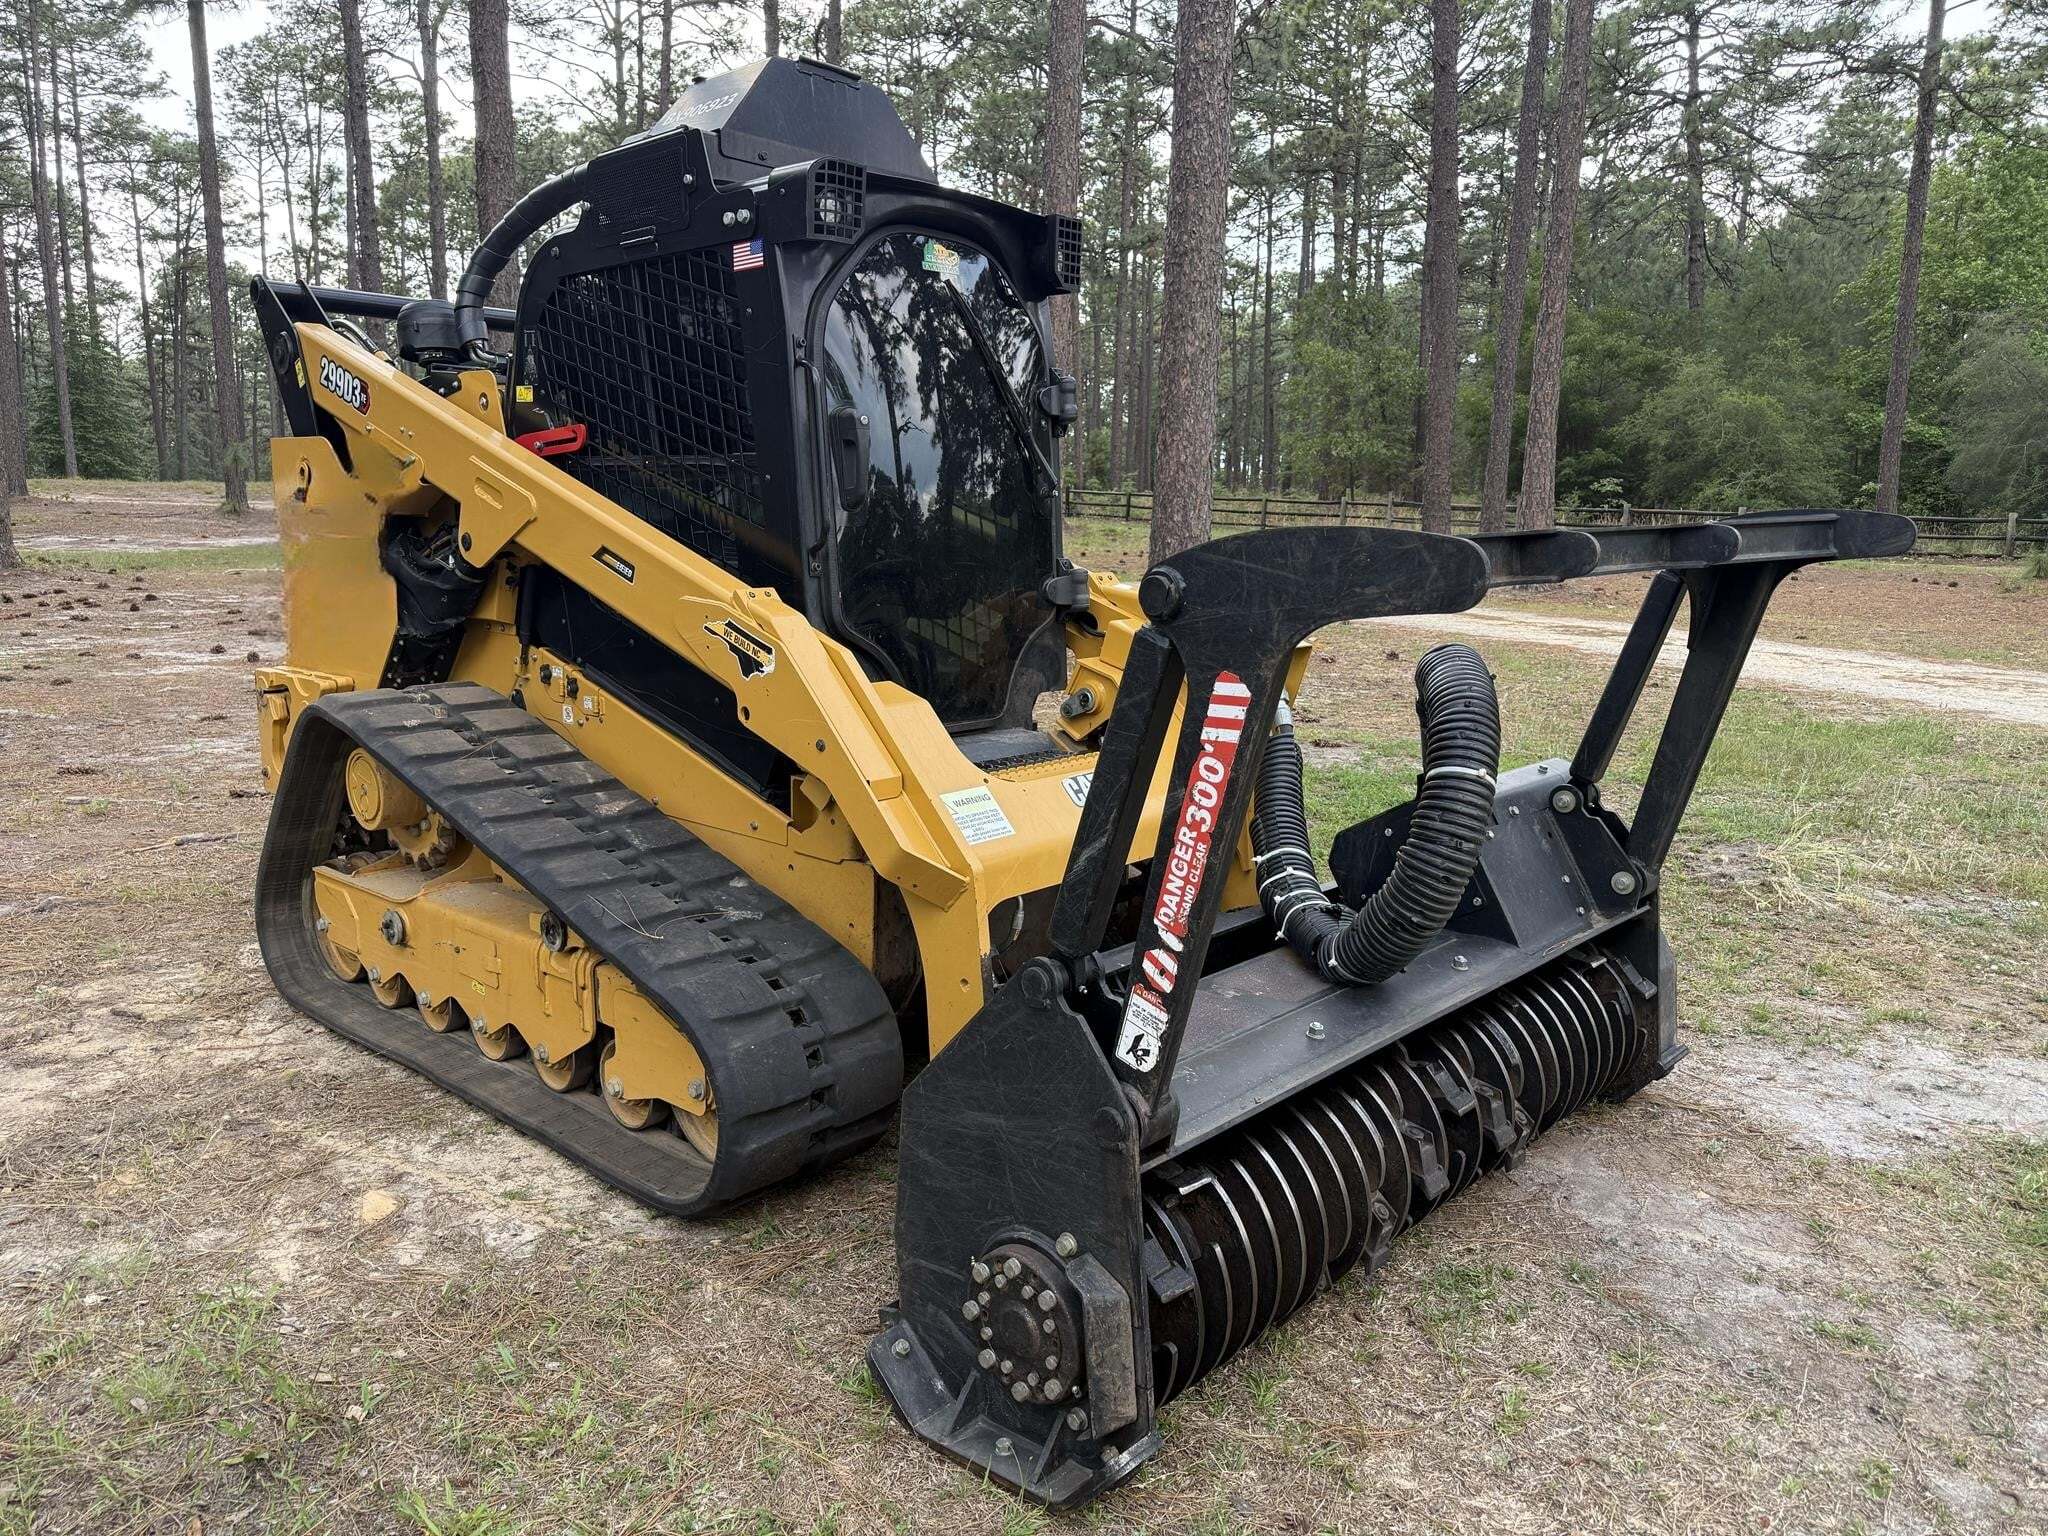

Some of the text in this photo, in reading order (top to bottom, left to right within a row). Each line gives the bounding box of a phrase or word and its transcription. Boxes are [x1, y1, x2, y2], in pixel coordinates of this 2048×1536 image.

[321, 355, 361, 409] 299D3
[723, 627, 761, 659] WE BUILD NC
[952, 793, 991, 808] WARNING
[1060, 771, 1094, 807] CA
[1158, 821, 1198, 924] DANGER
[1189, 841, 1207, 883] CLEAR
